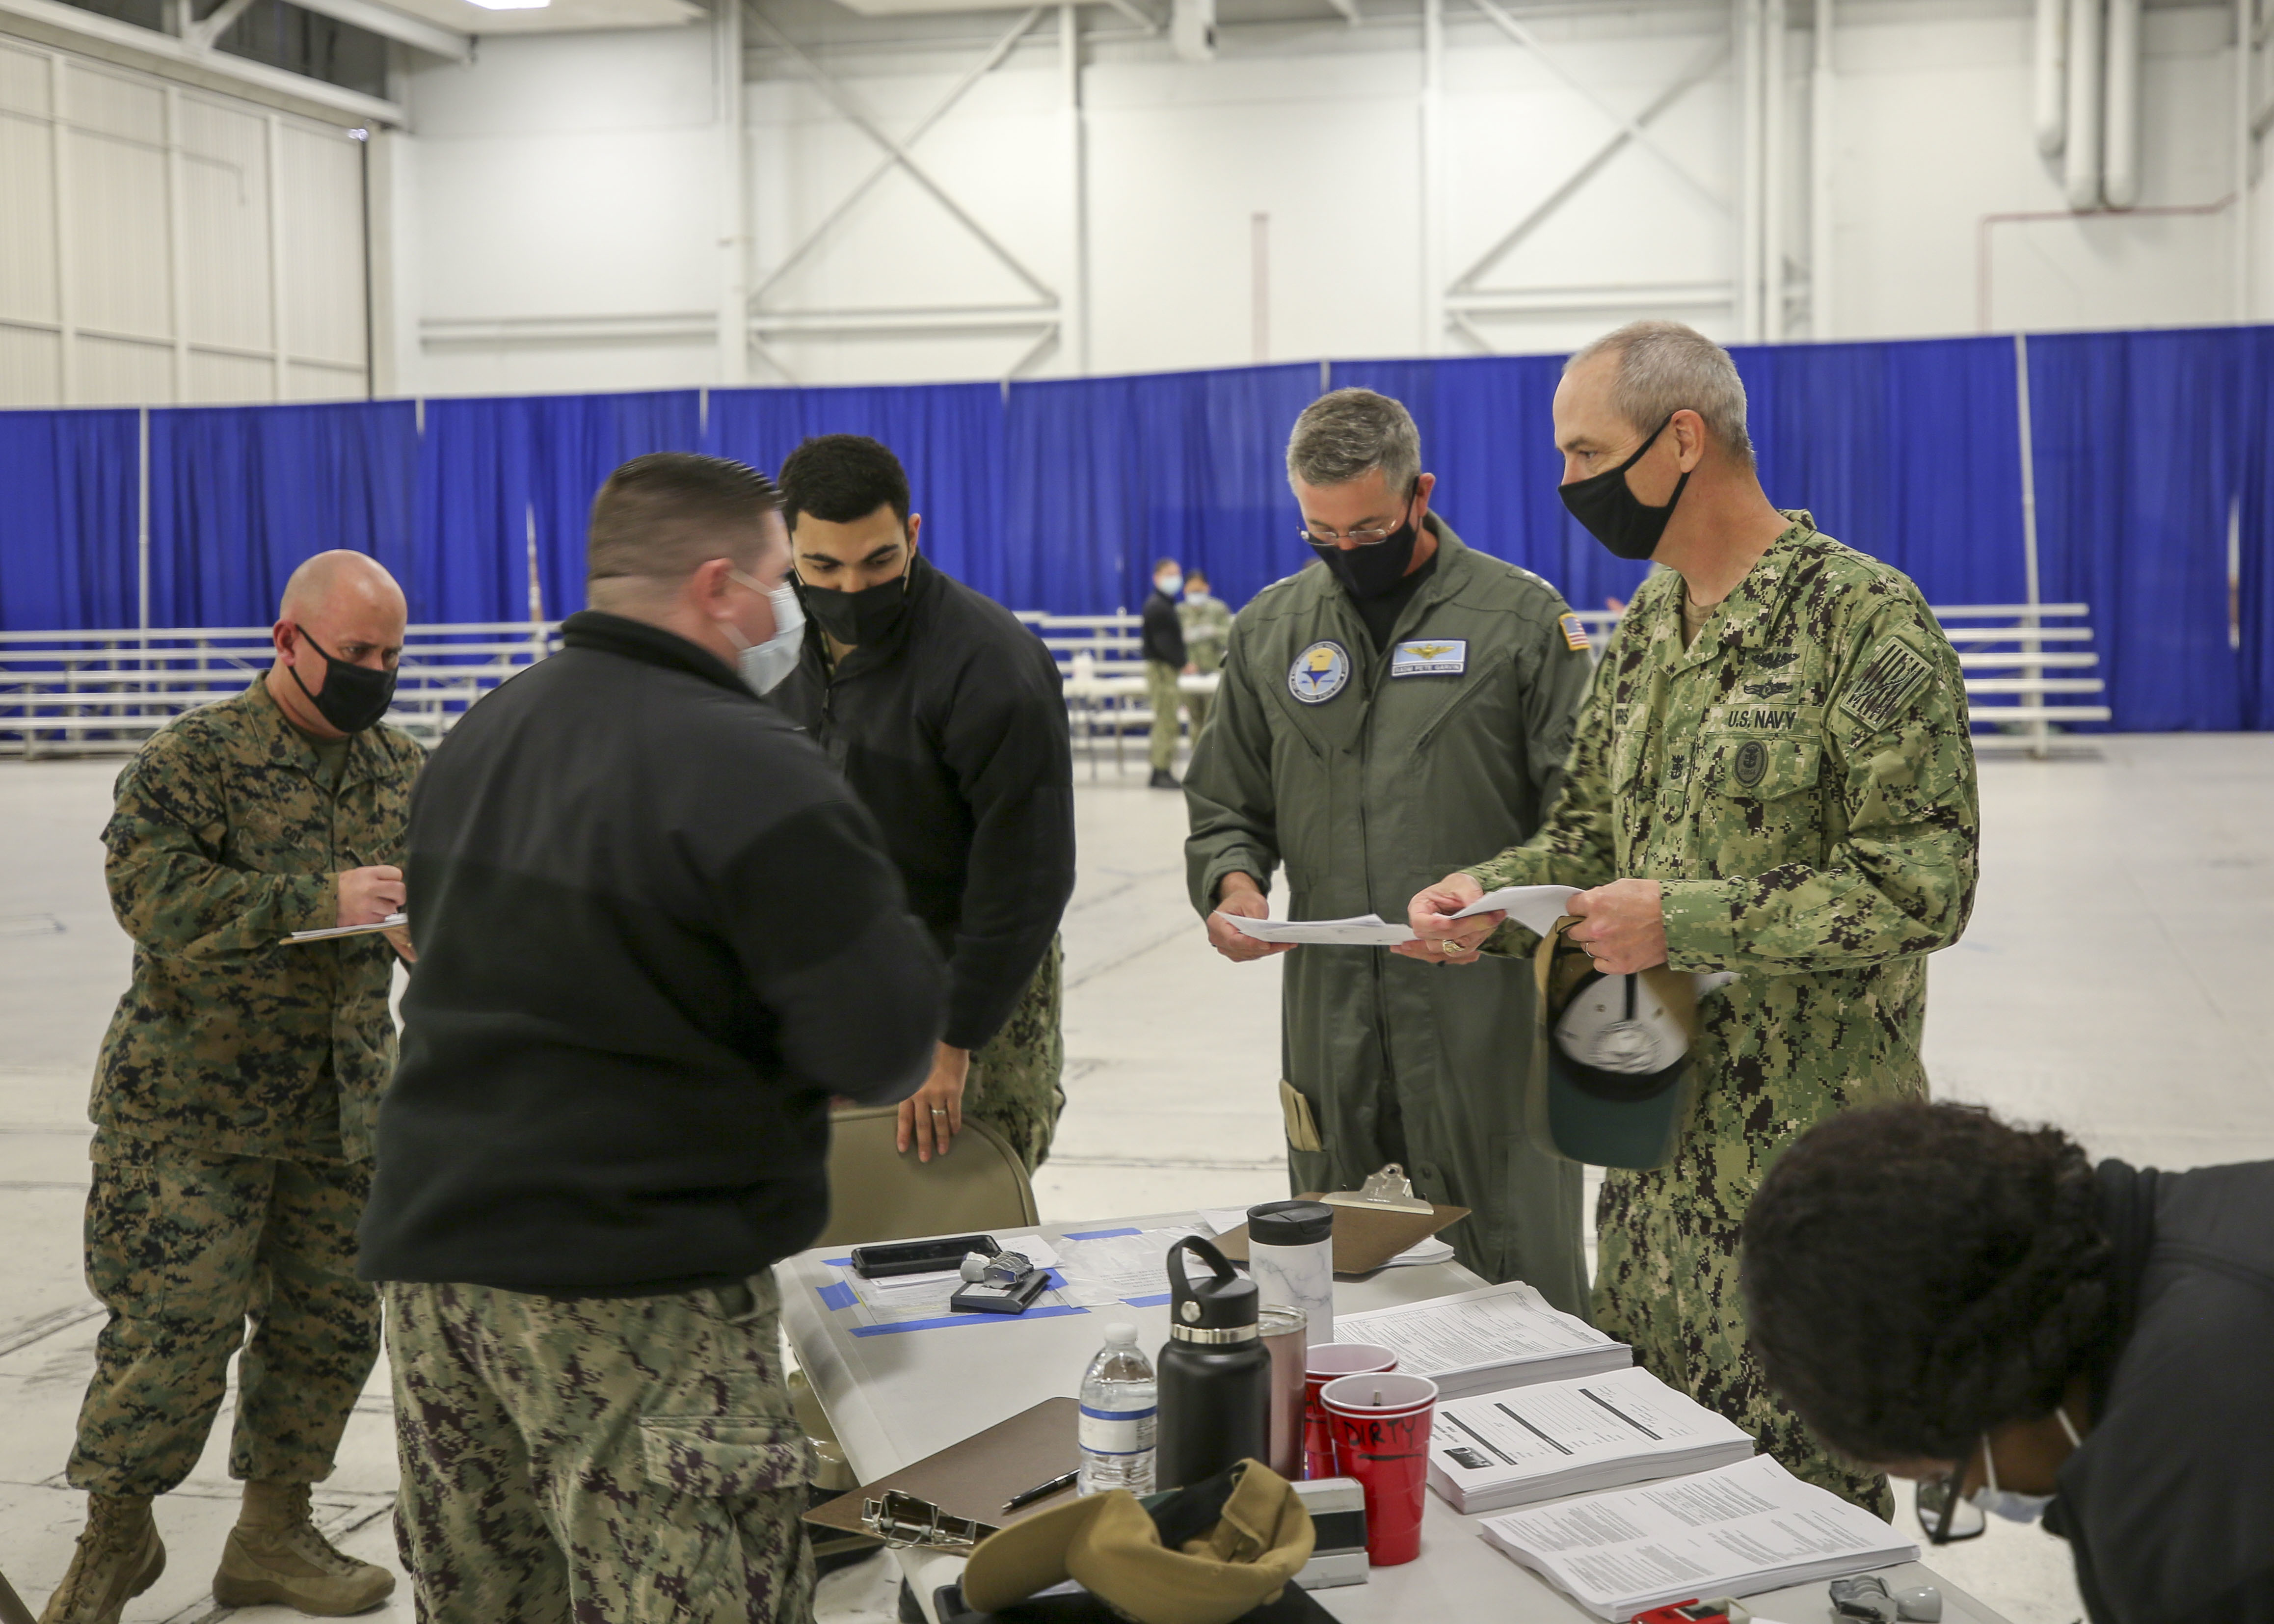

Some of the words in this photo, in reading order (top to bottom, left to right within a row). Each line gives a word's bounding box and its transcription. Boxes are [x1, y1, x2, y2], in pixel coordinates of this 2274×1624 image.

[1728, 710, 1750, 728] U.S.
[1755, 710, 1796, 730] NAVY
[1343, 1416, 1417, 1449] DIRTY
